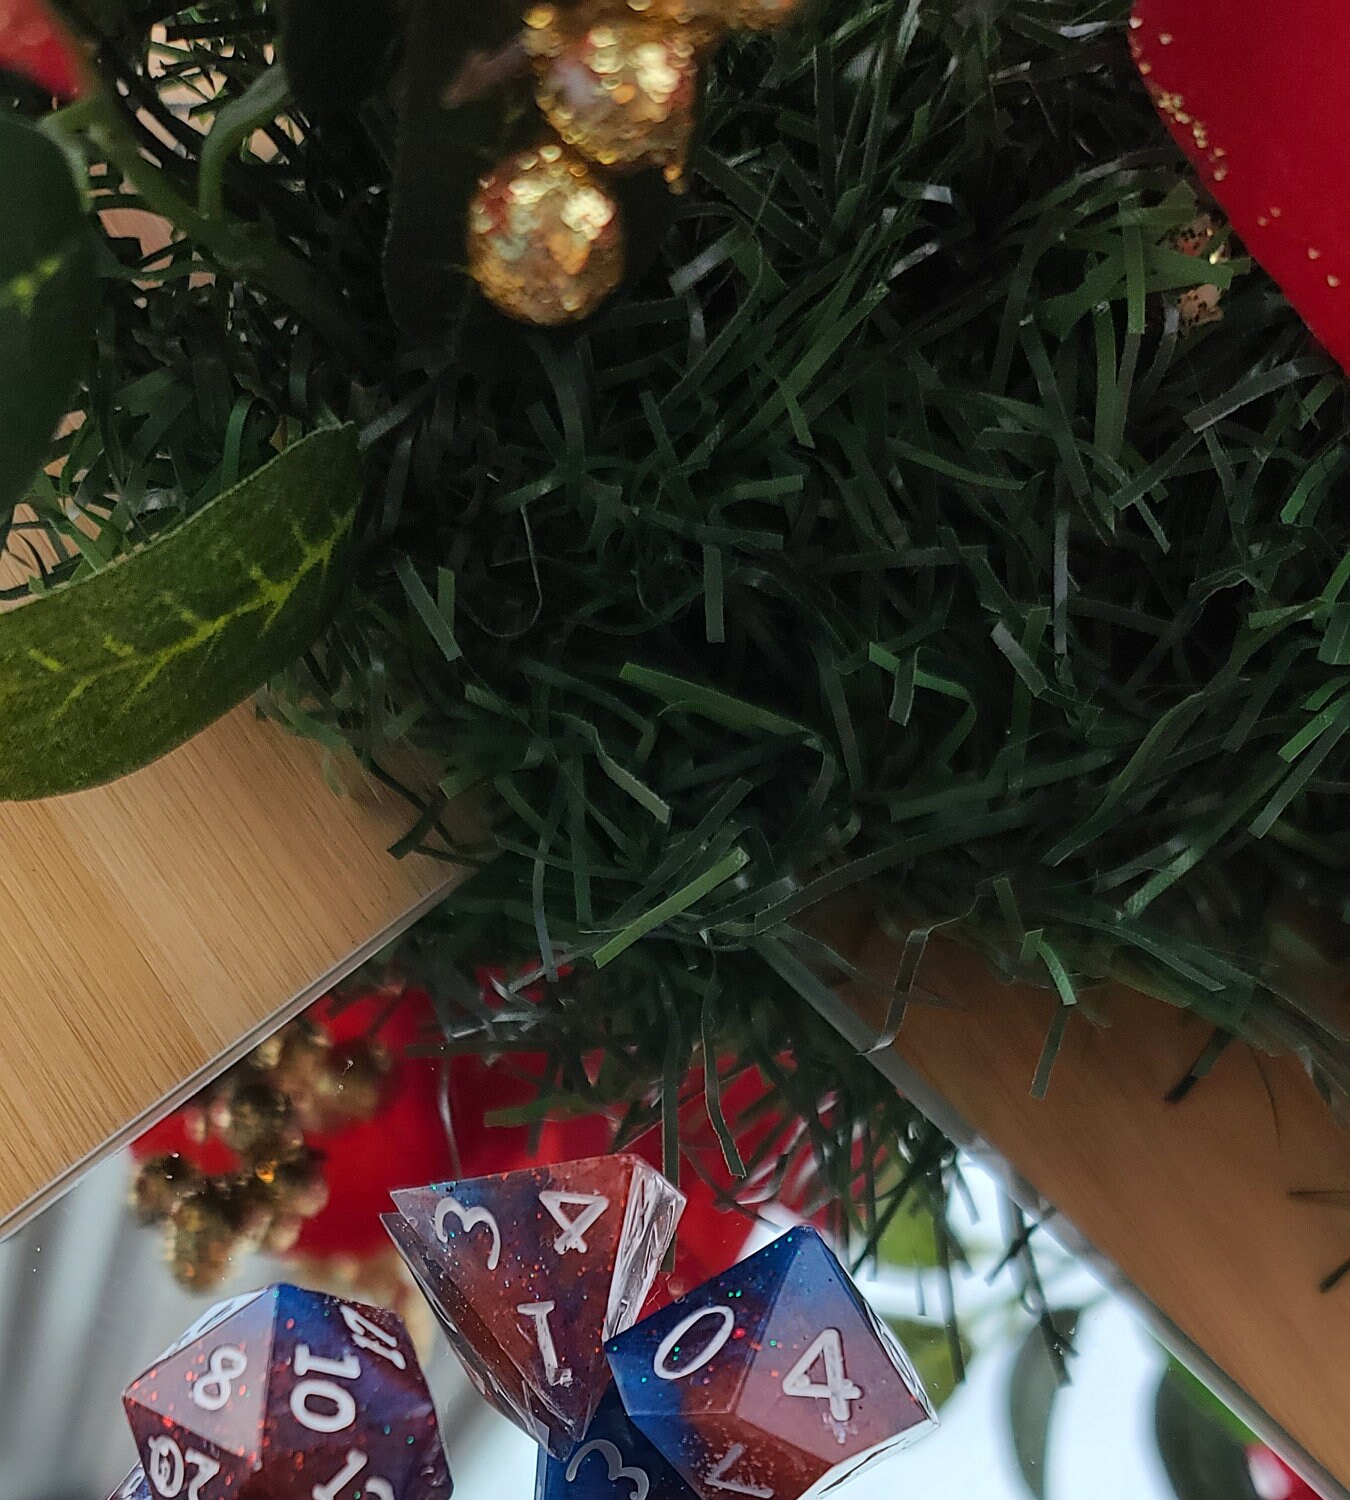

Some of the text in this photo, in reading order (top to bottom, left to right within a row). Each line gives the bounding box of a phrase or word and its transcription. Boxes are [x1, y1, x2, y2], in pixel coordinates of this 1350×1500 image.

[435, 1196, 500, 1271] 3
[539, 1190, 608, 1256] 4
[192, 1346, 248, 1411] 8
[653, 1304, 734, 1380] 0
[782, 1328, 863, 1422] 4
[289, 1343, 362, 1433] 10
